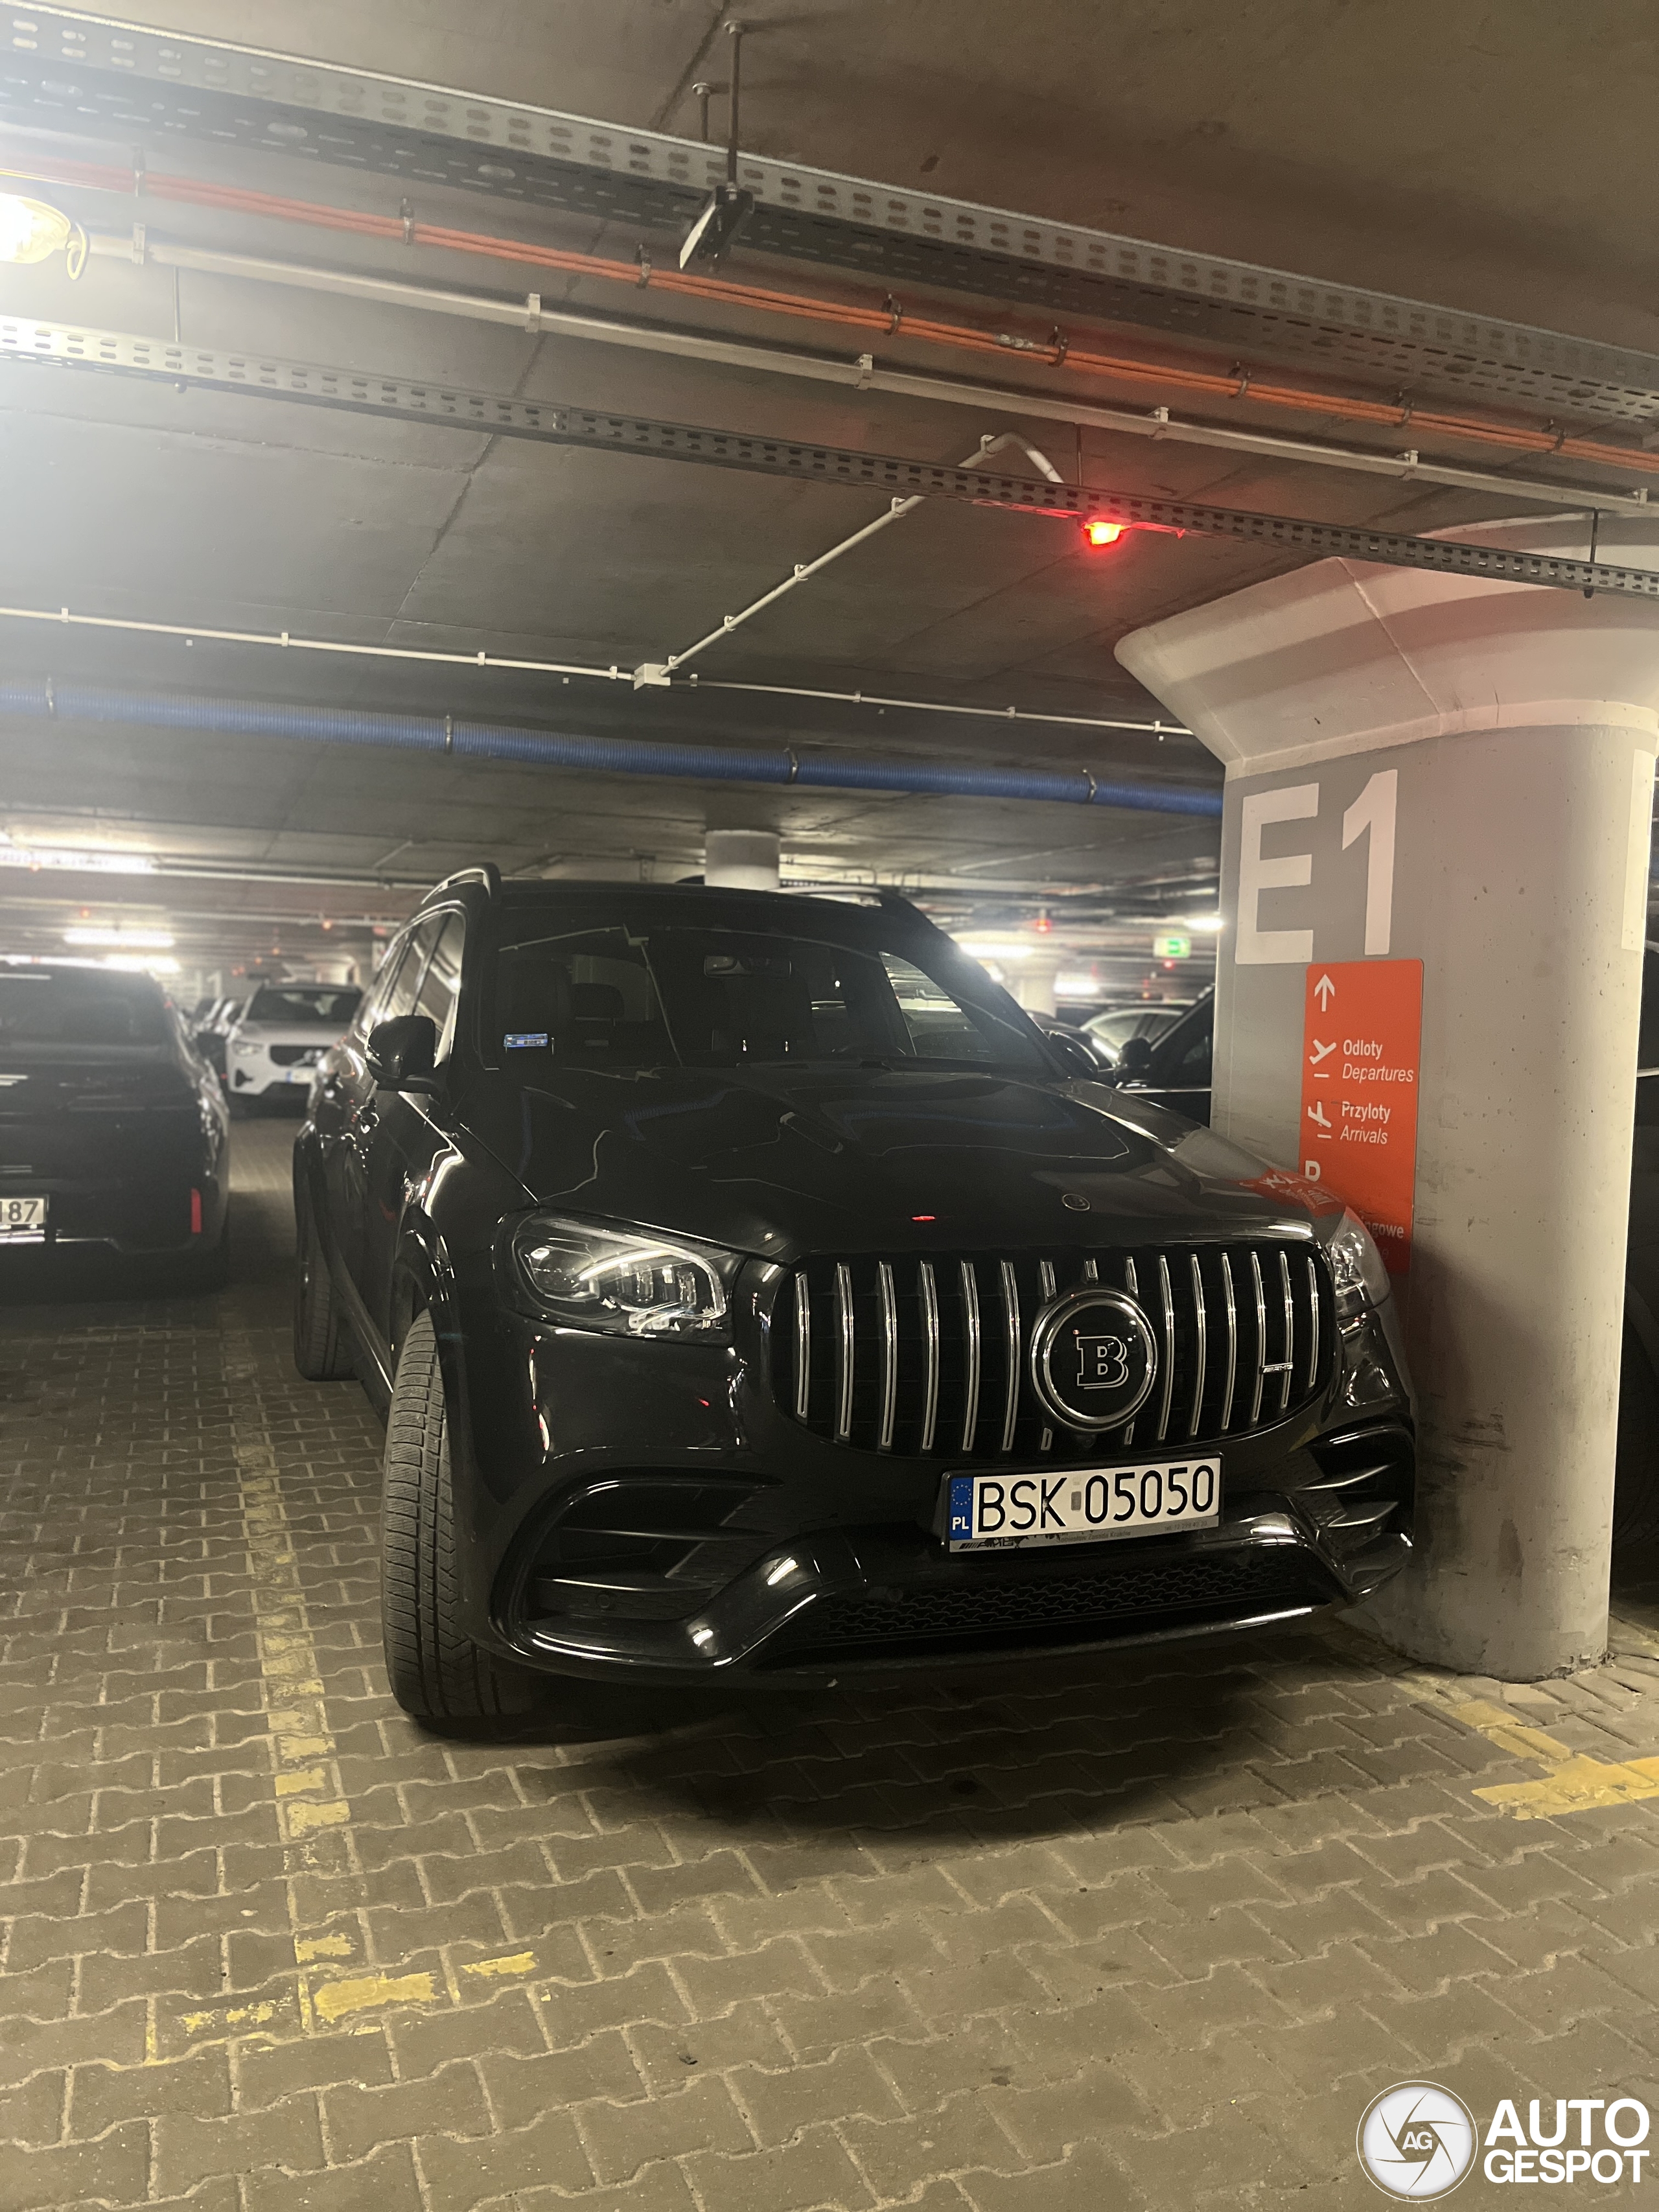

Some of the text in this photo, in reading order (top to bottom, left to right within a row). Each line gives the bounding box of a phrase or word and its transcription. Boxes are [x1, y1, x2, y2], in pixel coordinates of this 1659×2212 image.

[1235, 769, 1398, 964] E1
[1343, 1040, 1382, 1060] Odloty
[1342, 1063, 1413, 1084] Departures
[1341, 1101, 1391, 1124] Przyloty
[1340, 1125, 1388, 1145] Arrivals
[0, 1200, 38, 1222] 87
[1076, 1335, 1129, 1389] B
[977, 1465, 1214, 1533] BSK 05050
[952, 1517, 969, 1531] PL
